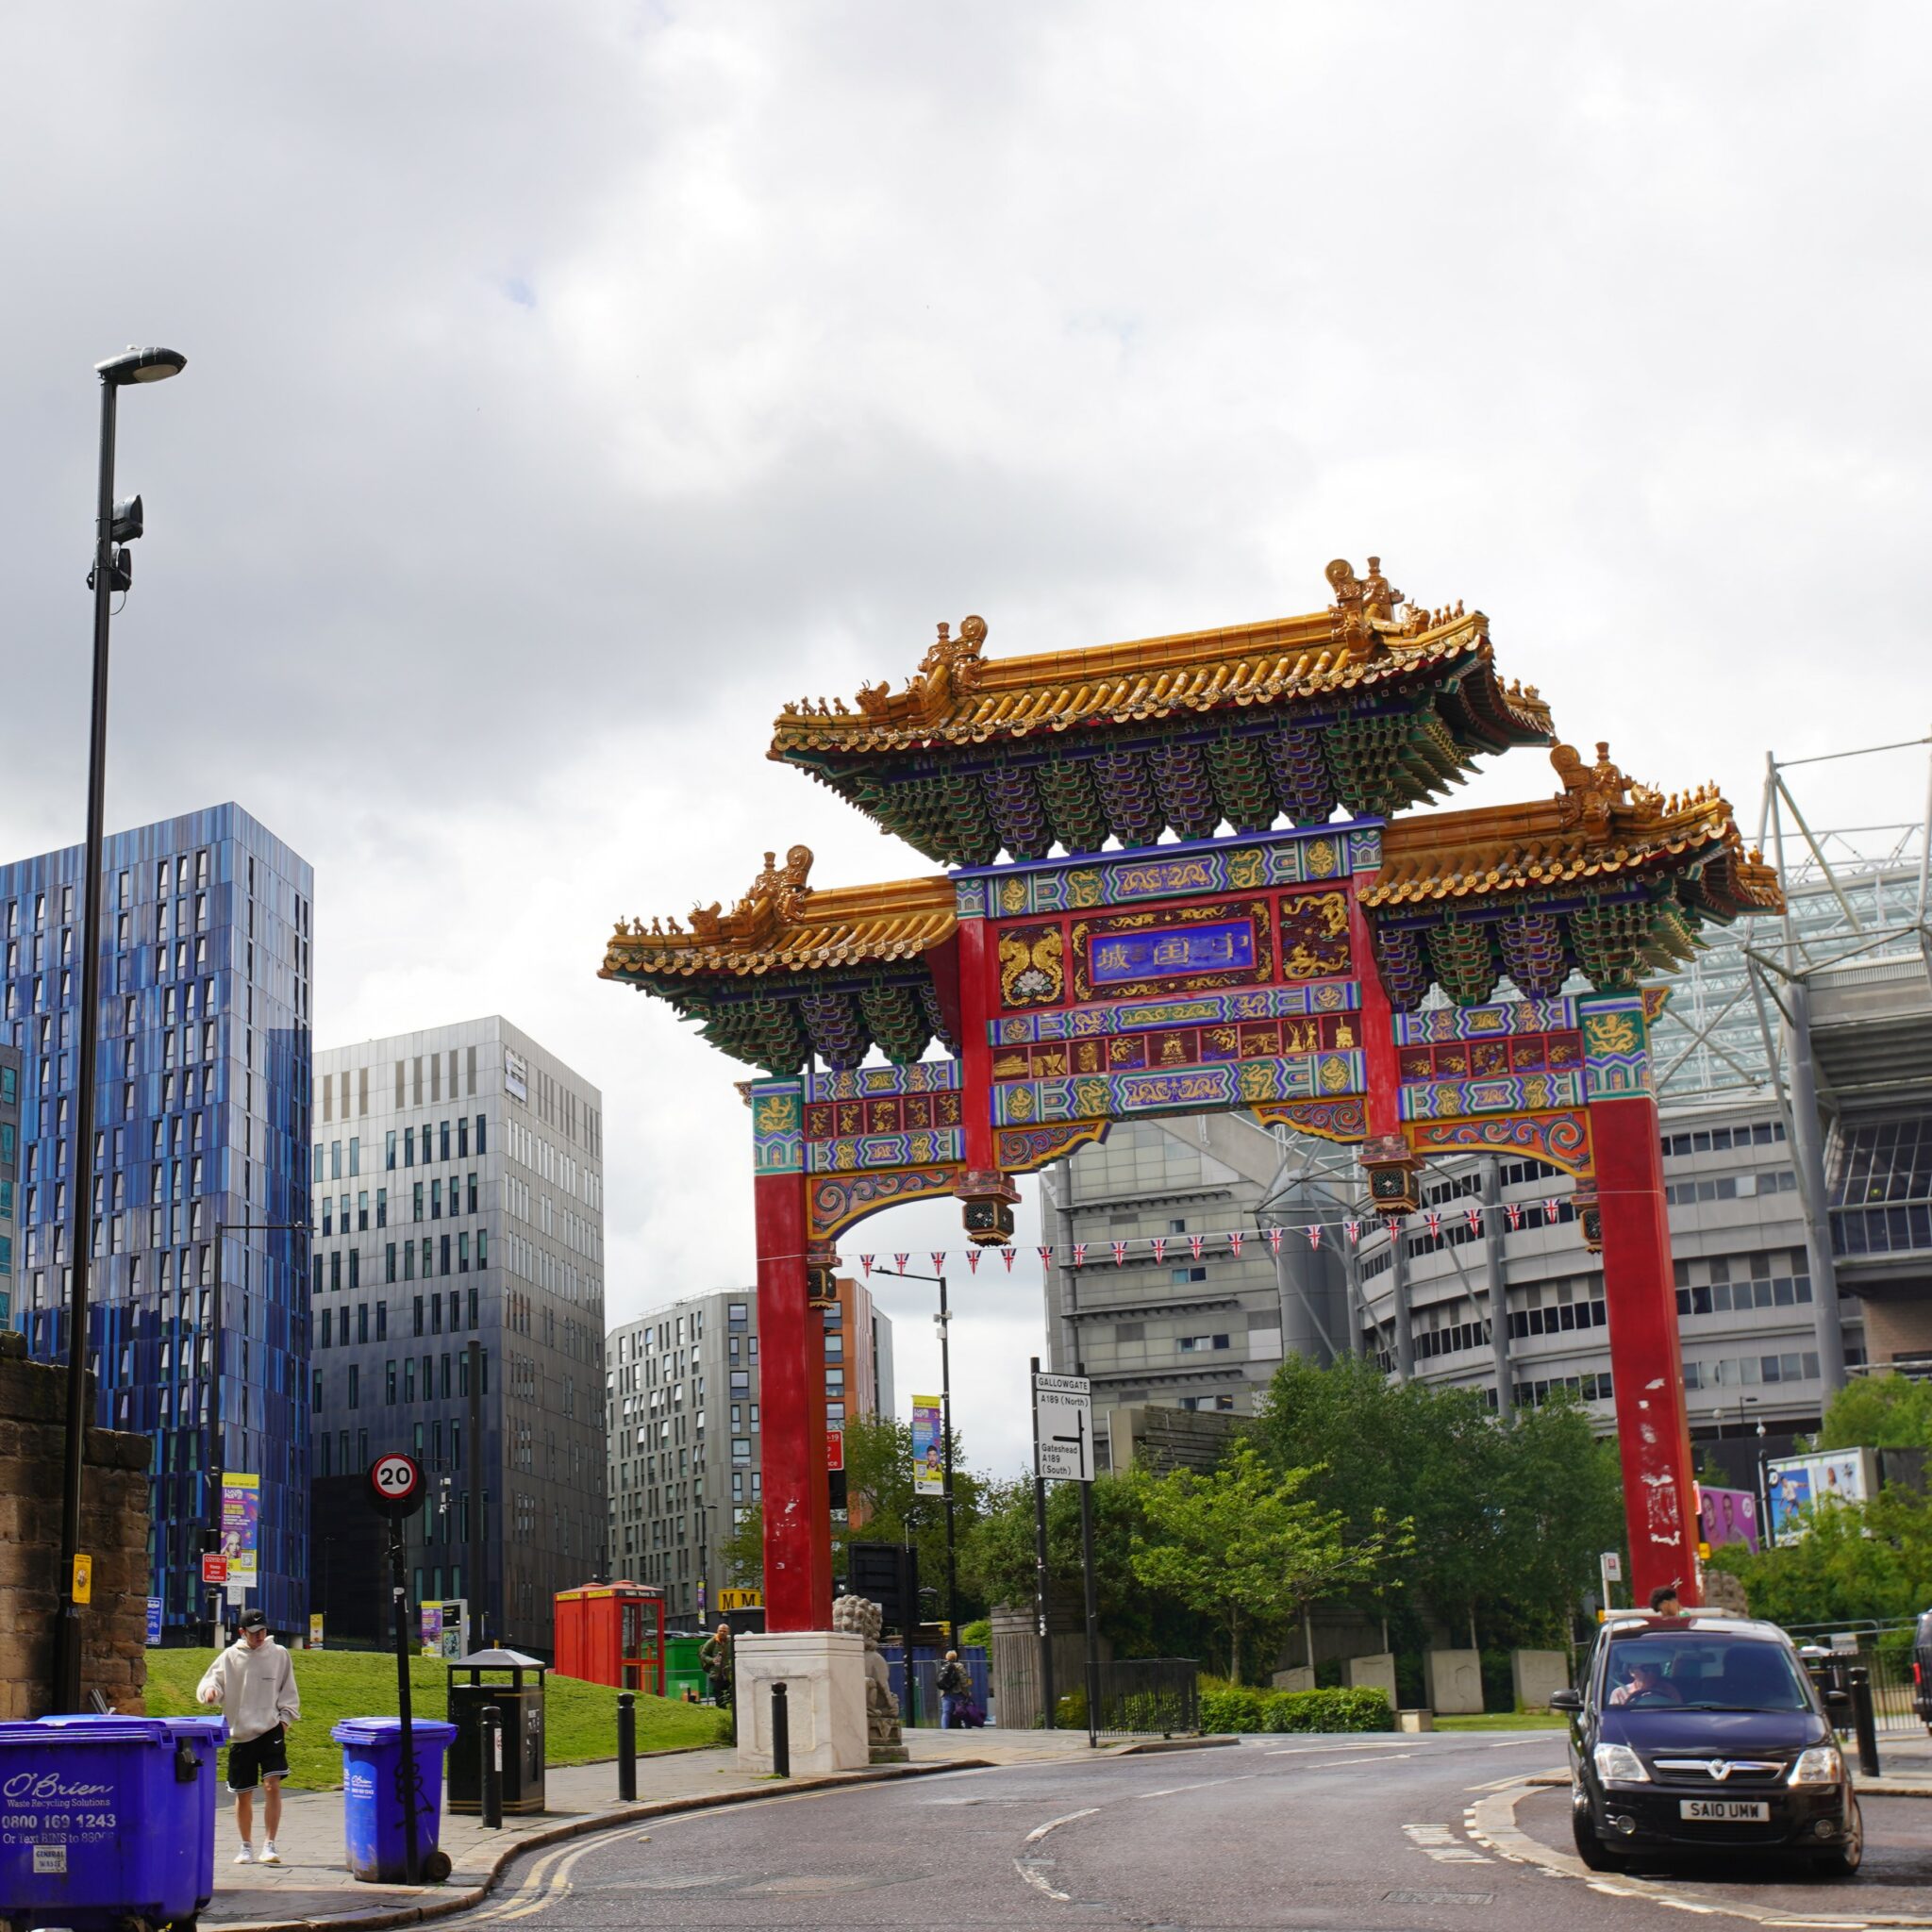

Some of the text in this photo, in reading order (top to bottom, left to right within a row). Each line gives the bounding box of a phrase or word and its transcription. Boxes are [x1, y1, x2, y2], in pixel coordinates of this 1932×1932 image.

[1039, 1377, 1088, 1391] GALLOWGATE
[1041, 1394, 1089, 1407] A189 (North)
[1041, 1443, 1077, 1454] Gateshead
[1041, 1454, 1060, 1463] A189
[380, 1467, 410, 1485] 20
[1041, 1464, 1072, 1475] (South)
[723, 1593, 734, 1609] M
[741, 1593, 756, 1606] M
[3, 1773, 114, 1798] O'Brien
[7, 1798, 110, 1808] Waste Recycling Solutions
[1690, 1803, 1759, 1818] SA10 UMW
[1, 1813, 117, 1828] 0800 169 1243
[3, 1833, 16, 1844] Or
